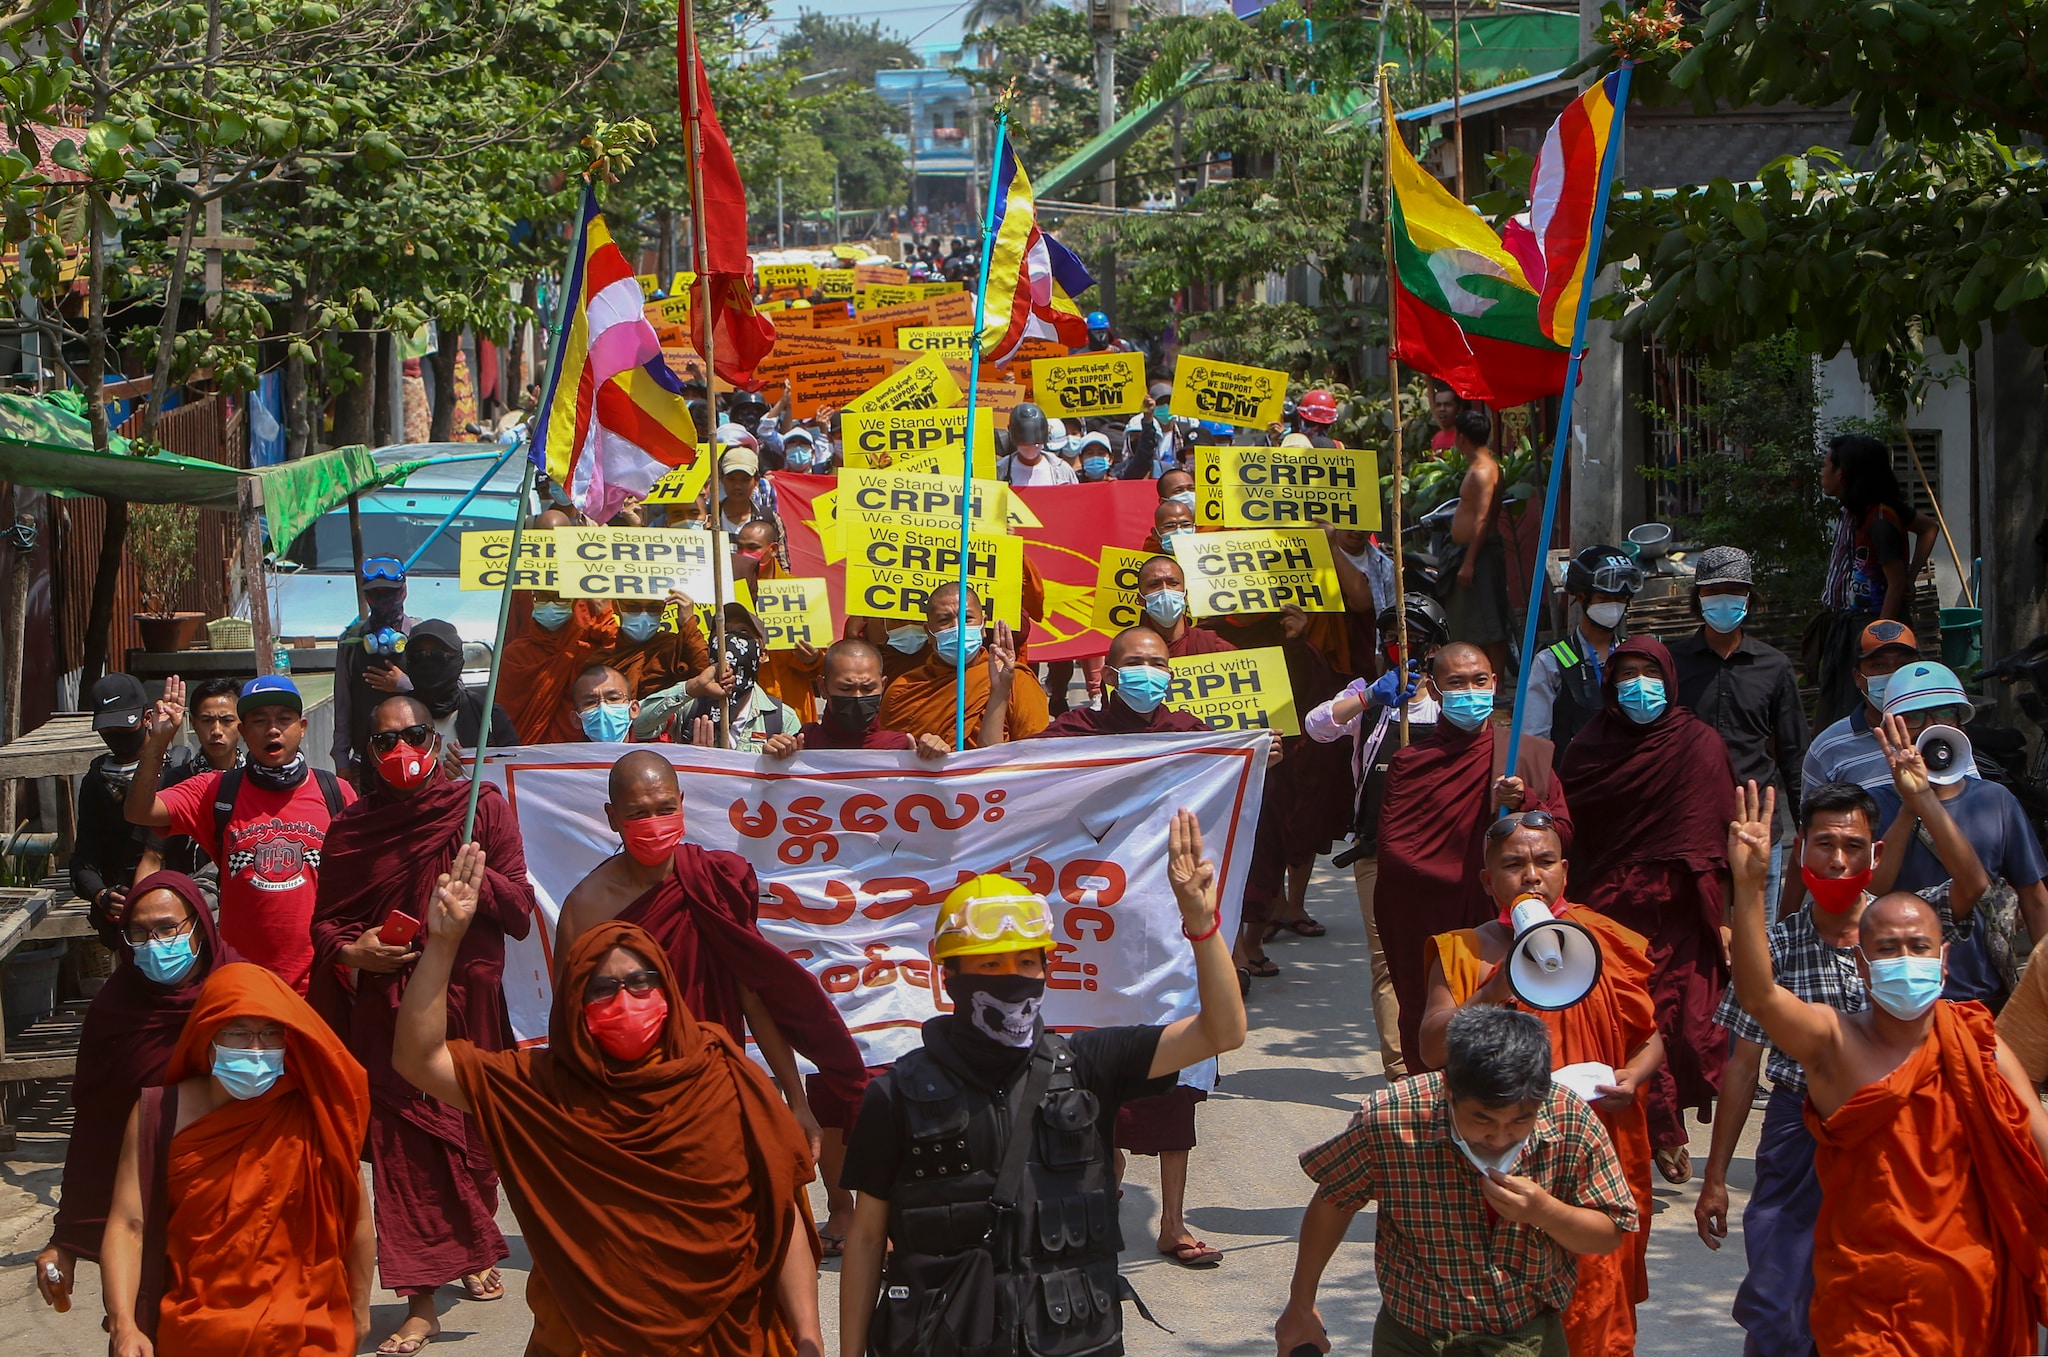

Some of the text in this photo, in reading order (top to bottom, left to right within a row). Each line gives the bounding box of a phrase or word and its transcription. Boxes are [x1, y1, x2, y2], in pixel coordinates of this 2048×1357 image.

[764, 267, 806, 276] CRPH
[823, 282, 853, 294] CDM
[662, 303, 687, 316] PH
[926, 330, 952, 338] Stand
[908, 336, 973, 350] CRPH
[938, 350, 971, 358] upport
[1066, 373, 1112, 385] WE SUPPORT
[1207, 379, 1253, 394] WE SUPPORT
[878, 400, 891, 412] WE
[891, 382, 919, 404] SUPPORT
[1059, 382, 1124, 408] CDM
[1196, 388, 1261, 418] CDM
[859, 414, 968, 430] We Stand with
[858, 427, 967, 451] CRPH
[907, 456, 938, 473] with
[1205, 452, 1220, 464] We
[1239, 452, 1355, 467] We Stand with
[859, 475, 887, 488] We
[893, 477, 943, 492] Stand
[1238, 463, 1356, 488] CRPH
[1208, 487, 1223, 499] We
[1245, 487, 1352, 502] We Support
[856, 487, 982, 518] CRPH
[1240, 499, 1358, 525] CRPH
[862, 511, 976, 532] We Suppot
[482, 534, 555, 544] We Stan
[577, 532, 704, 546] We Stand with
[869, 527, 997, 553] We Stand with
[1193, 536, 1307, 555] We Stand with
[576, 542, 706, 565] CRPH
[866, 541, 996, 579] CRPH
[1197, 548, 1313, 576] CRPH
[584, 563, 616, 573] We
[1119, 557, 1144, 570] We
[872, 568, 904, 584] We
[1207, 572, 1313, 590] We Support
[776, 583, 805, 594] with
[758, 594, 807, 612] PH
[864, 585, 994, 622] CRH
[1209, 585, 1324, 613] CRPH
[763, 614, 804, 625] pport
[765, 624, 811, 644] PH
[1220, 657, 1258, 672] with
[1165, 670, 1262, 703] RPH
[1204, 710, 1270, 731] PH
[728, 788, 1008, 865] မန္တလေး
[257, 880, 299, 890] Motorcycles
